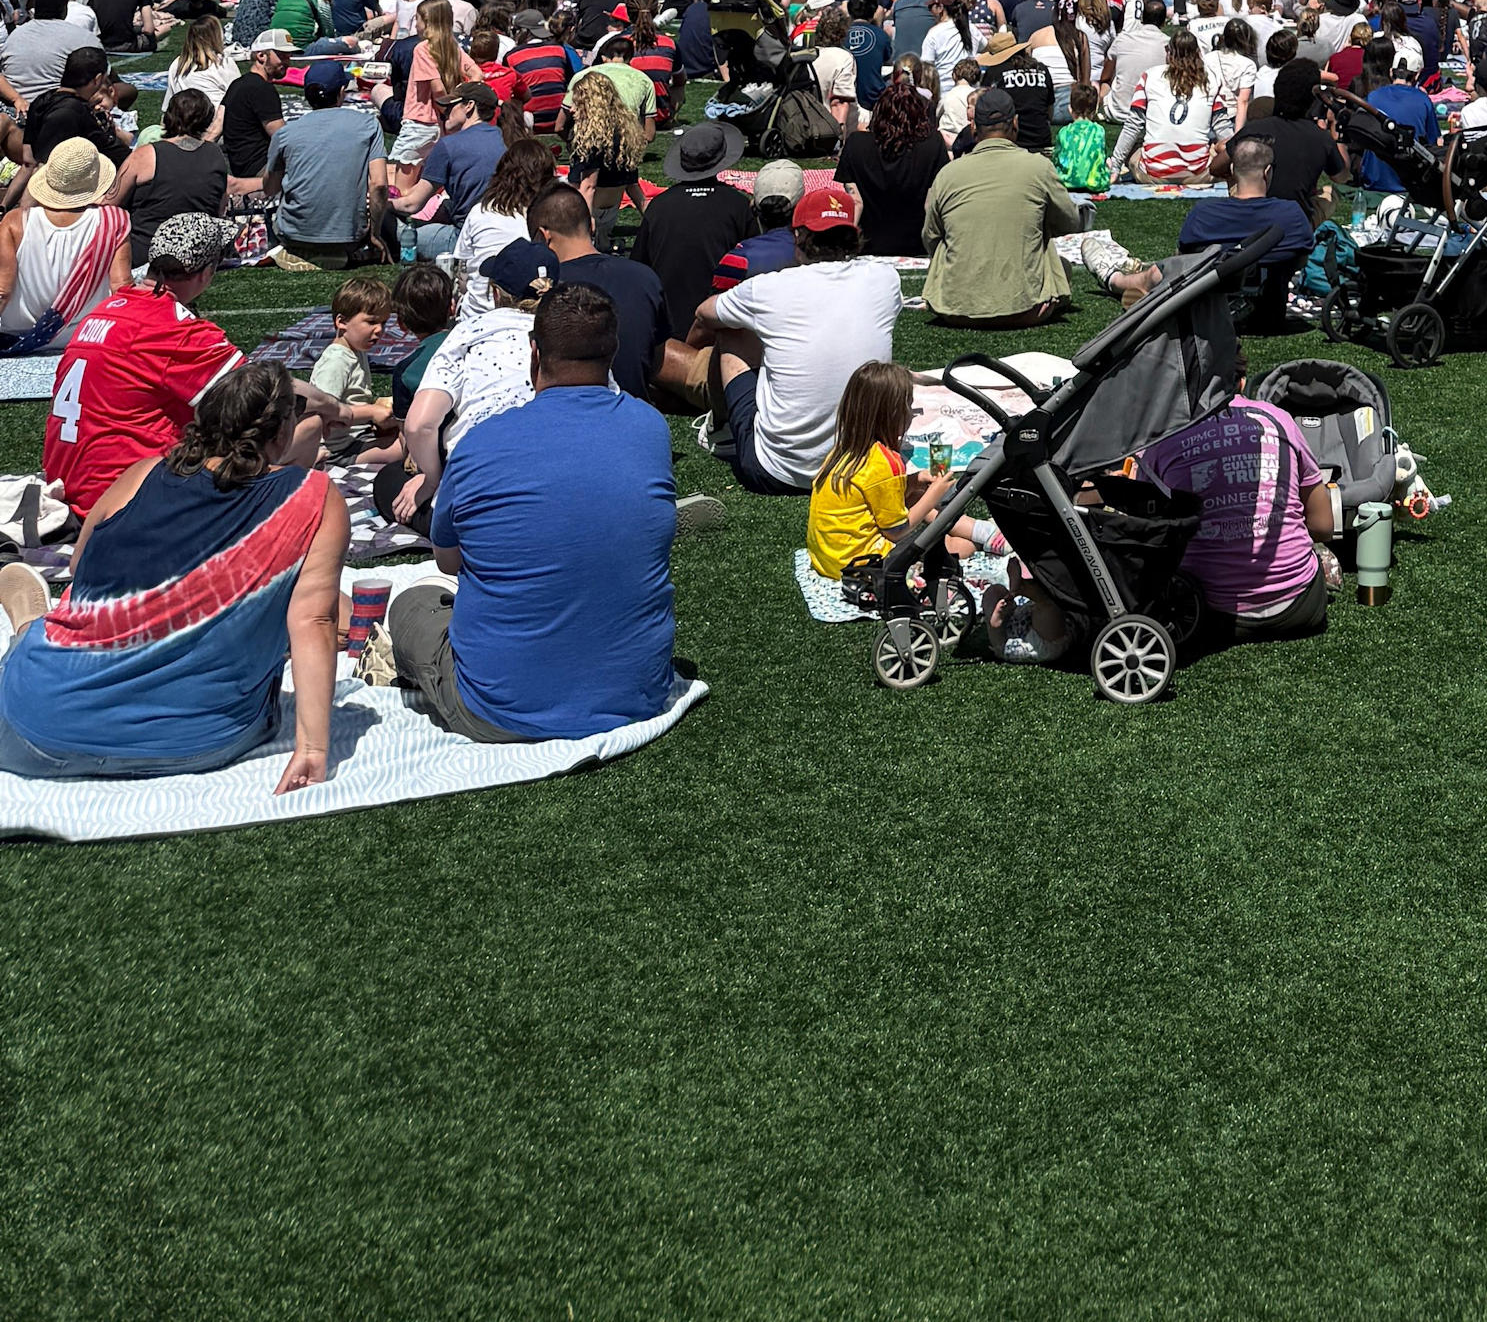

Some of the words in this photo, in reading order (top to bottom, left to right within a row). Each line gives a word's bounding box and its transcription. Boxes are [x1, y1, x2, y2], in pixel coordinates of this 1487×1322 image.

[1134, 0, 1144, 20] 8
[1471, 20, 1482, 40] 8
[1004, 71, 1047, 89] TOUR
[77, 318, 116, 344] COOK
[53, 357, 88, 444] 4
[1181, 428, 1217, 449] UPMC
[1182, 436, 1243, 459] URGENT
[1250, 434, 1280, 447] CARE
[1221, 452, 1279, 462] PITTSBURGH
[1222, 458, 1279, 471] CULTURAL
[1224, 468, 1279, 485] TRUST
[1077, 535, 1101, 578] BRAVO
